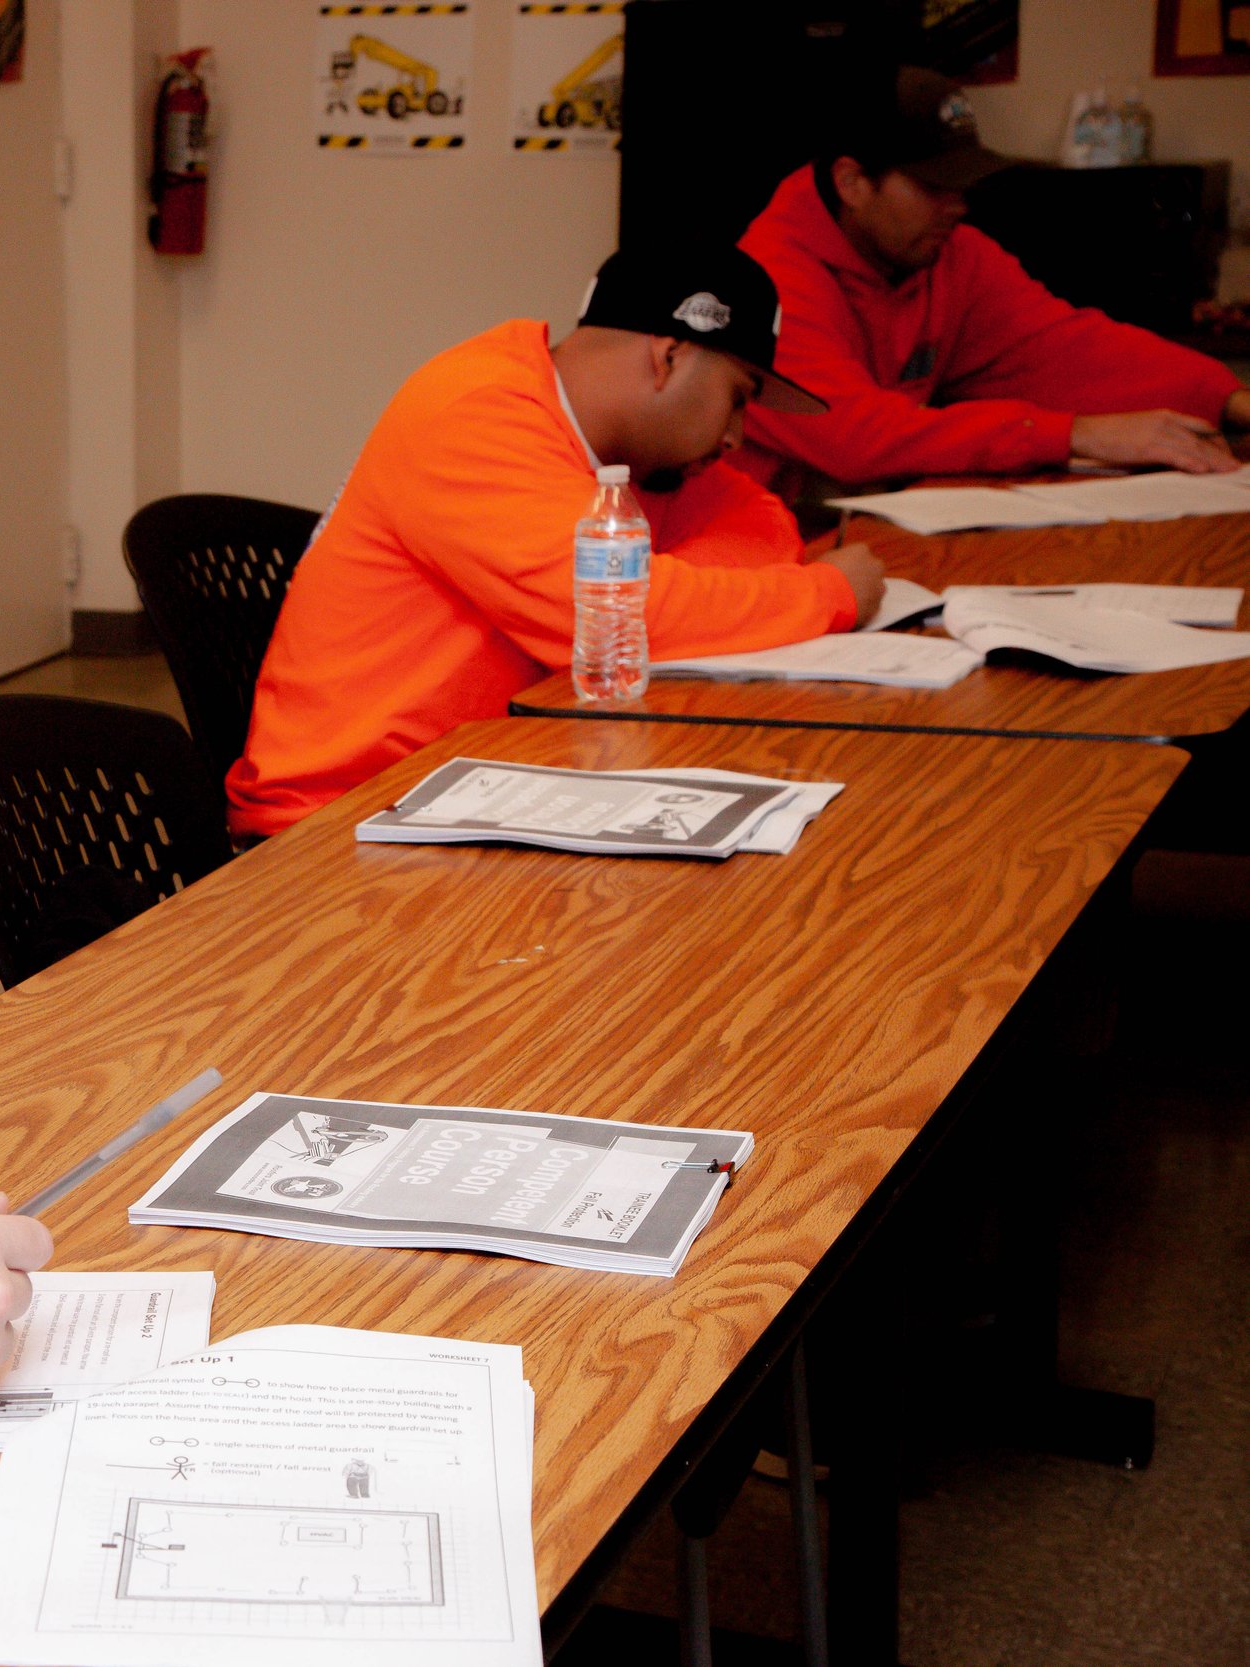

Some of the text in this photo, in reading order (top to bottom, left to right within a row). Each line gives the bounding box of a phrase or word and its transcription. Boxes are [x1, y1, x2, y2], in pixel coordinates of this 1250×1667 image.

[400, 1128, 482, 1186] Course
[452, 1136, 541, 1195] Person
[491, 1148, 589, 1226] Competent
[561, 1191, 603, 1229] Fall Protection
[609, 1214, 637, 1240] BOOKLET
[146, 1292, 161, 1315] Guardrail
[144, 1314, 157, 1326] Set
[201, 1356, 221, 1364] Up
[429, 1353, 480, 1361] WORKSHEET
[213, 1440, 243, 1449] single
[245, 1441, 283, 1450] section
[284, 1443, 296, 1451] of
[297, 1443, 328, 1452] metal
[329, 1444, 375, 1454] guardrail
[211, 1468, 261, 1477] (optional)
